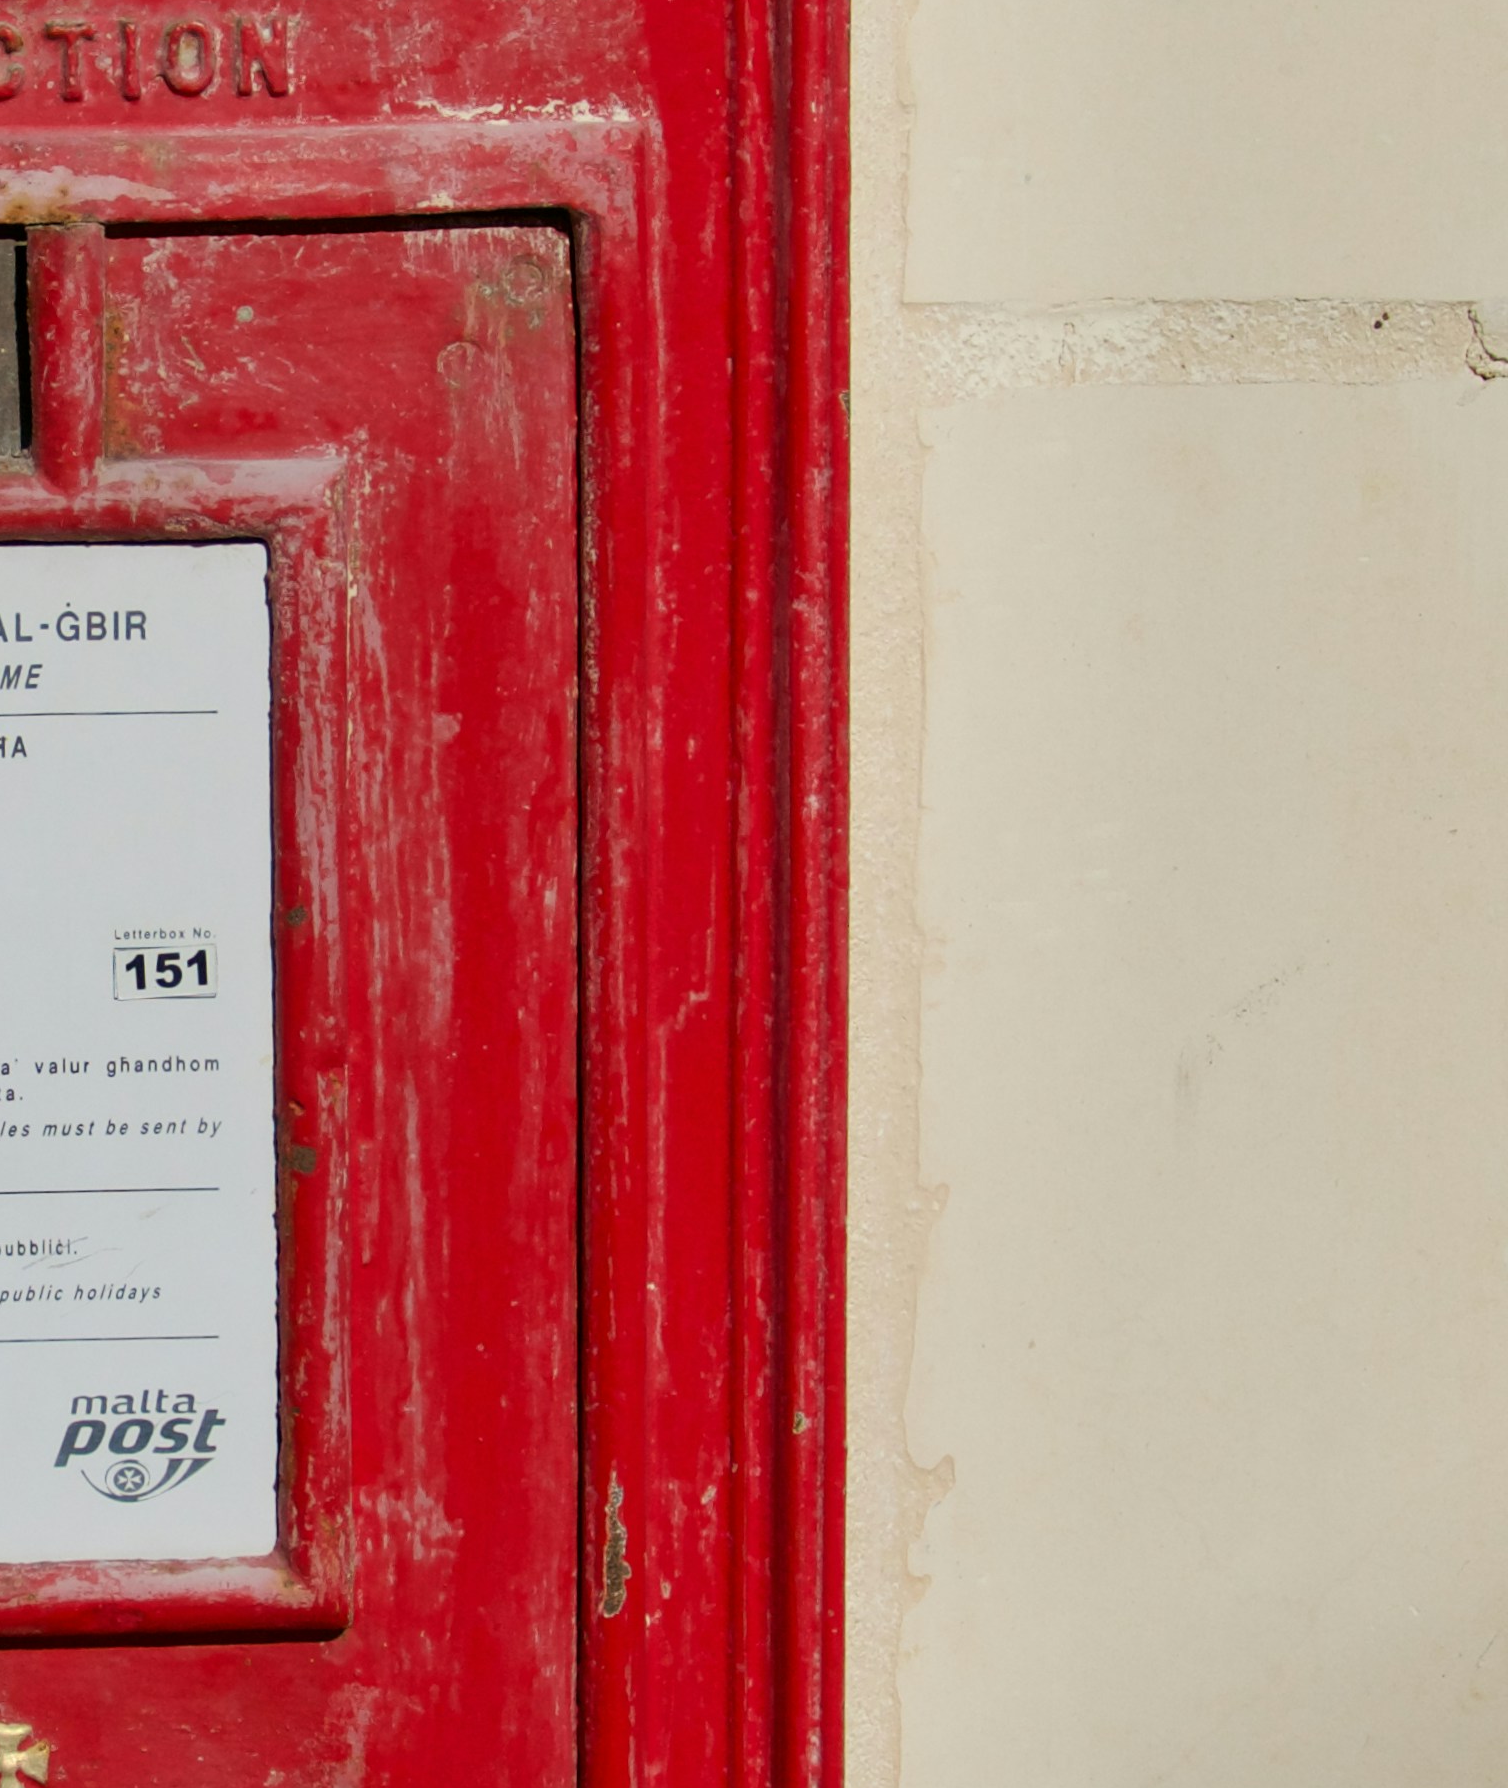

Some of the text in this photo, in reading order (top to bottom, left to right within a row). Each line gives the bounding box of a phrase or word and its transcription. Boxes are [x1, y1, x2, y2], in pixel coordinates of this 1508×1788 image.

[114, 926, 216, 941] Letterbox No.
[122, 946, 209, 991] 151
[34, 1057, 90, 1076] valur
[106, 1054, 220, 1079] għandhom
[41, 1120, 96, 1137] must
[104, 1118, 129, 1136] be
[139, 1118, 187, 1136] sent
[196, 1116, 223, 1139] by
[73, 1283, 162, 1304] holidays
[70, 1388, 198, 1416] malta
[53, 1405, 228, 1471] post
